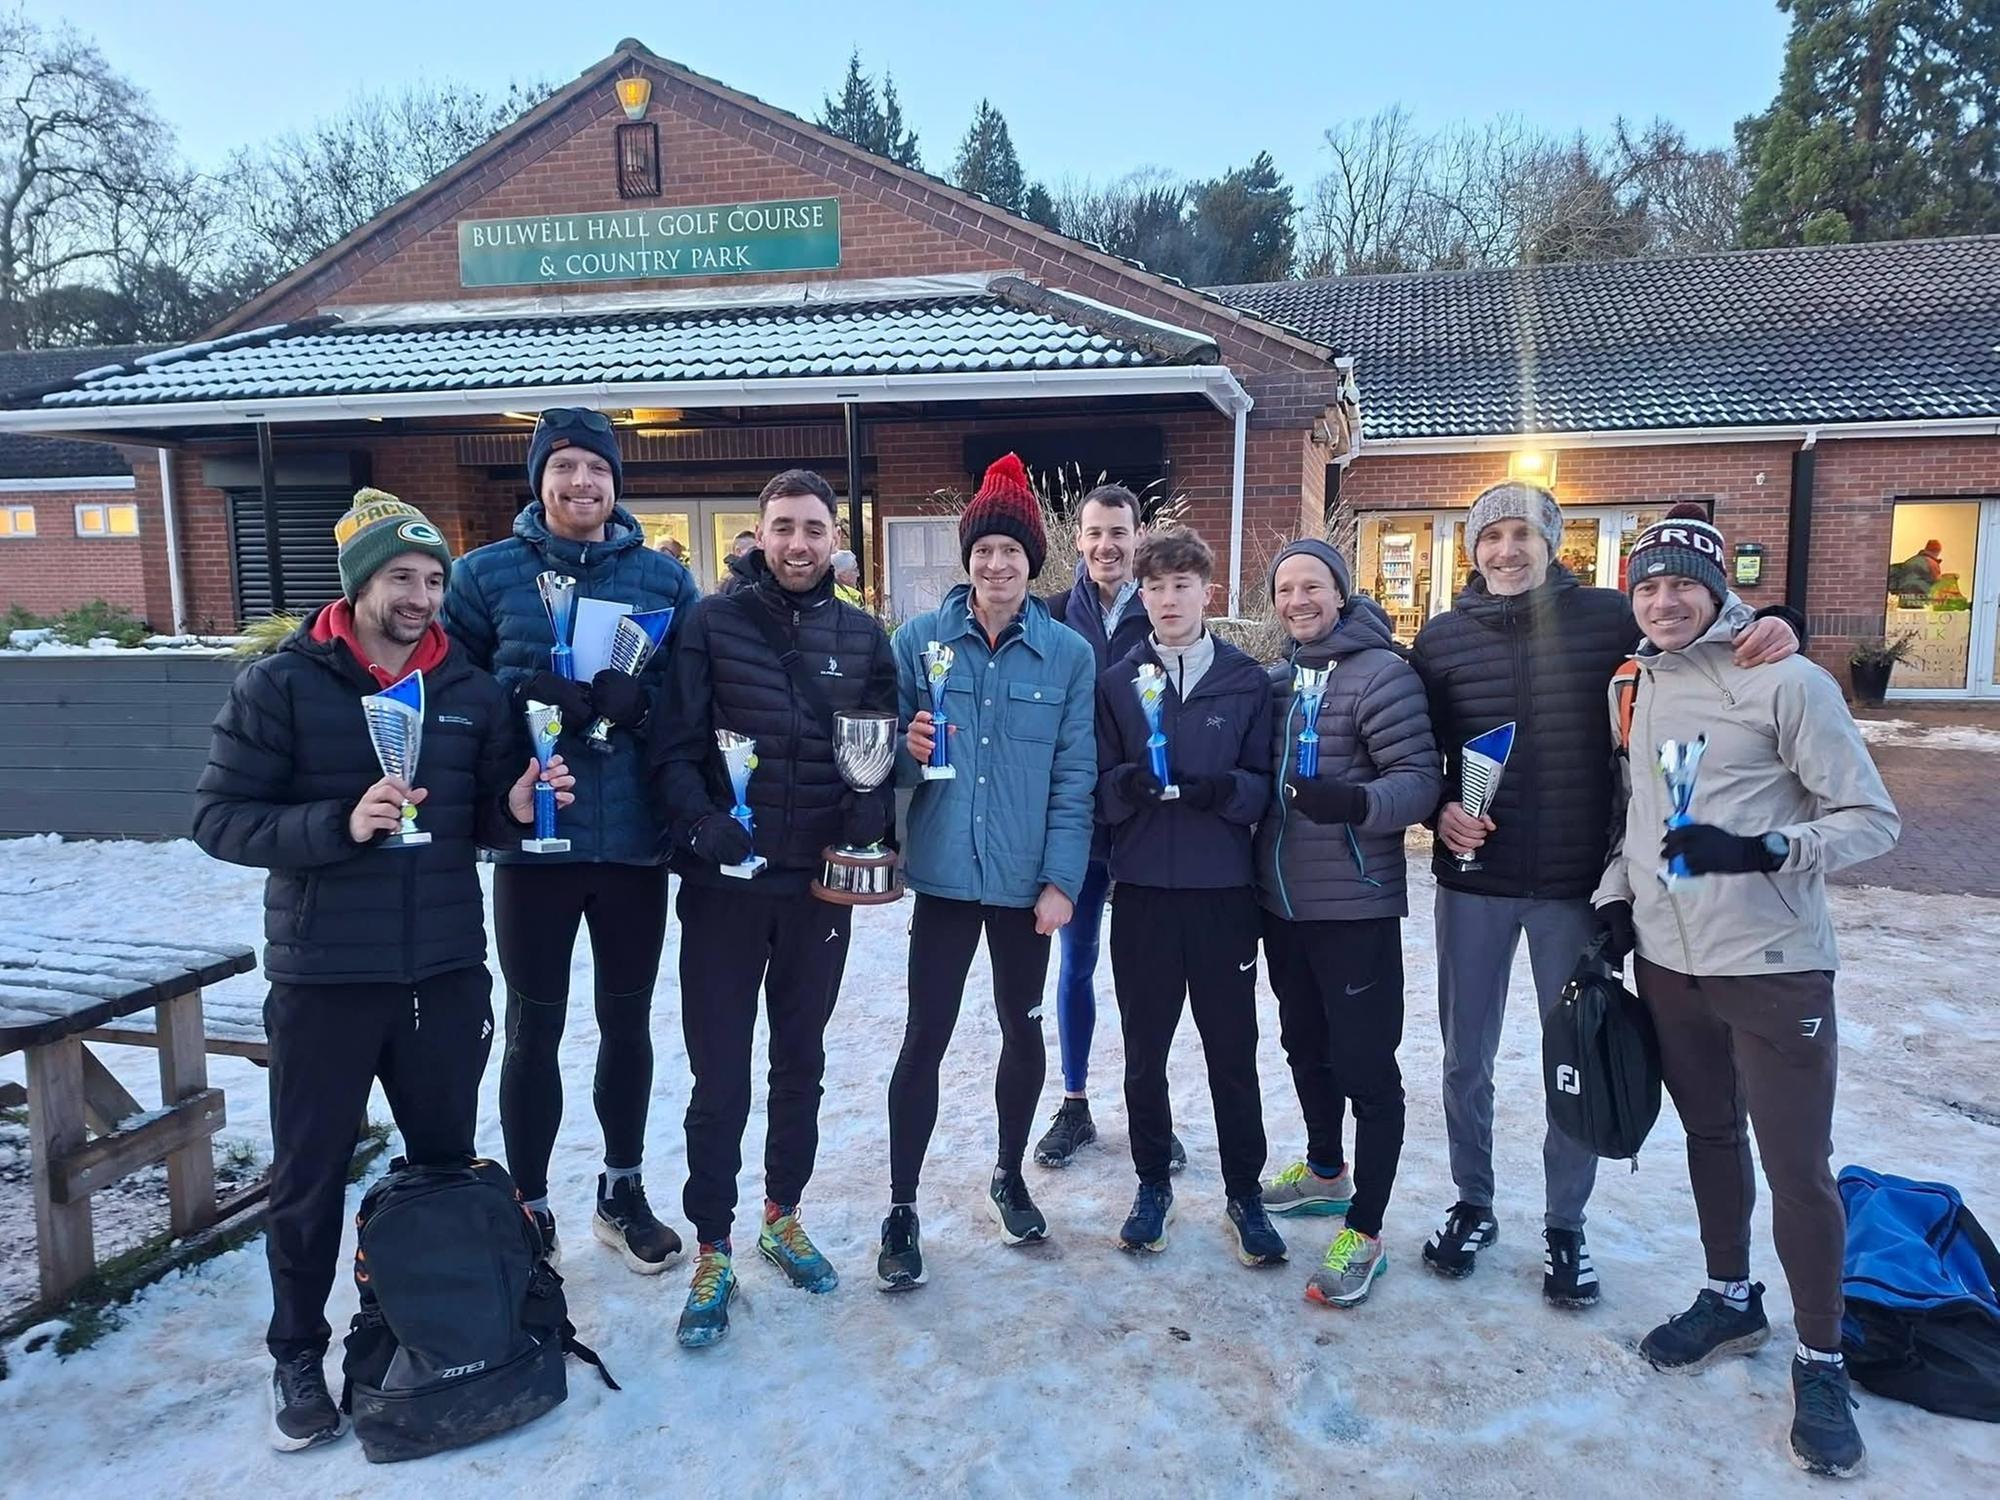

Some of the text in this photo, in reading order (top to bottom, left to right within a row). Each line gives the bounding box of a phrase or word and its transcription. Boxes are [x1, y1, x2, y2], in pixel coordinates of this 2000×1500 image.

[472, 205, 824, 247] BULWELL HALL GOLF COURSE
[539, 245, 752, 276] & COUNTRY PARK
[1556, 1064, 1581, 1095] FJ
